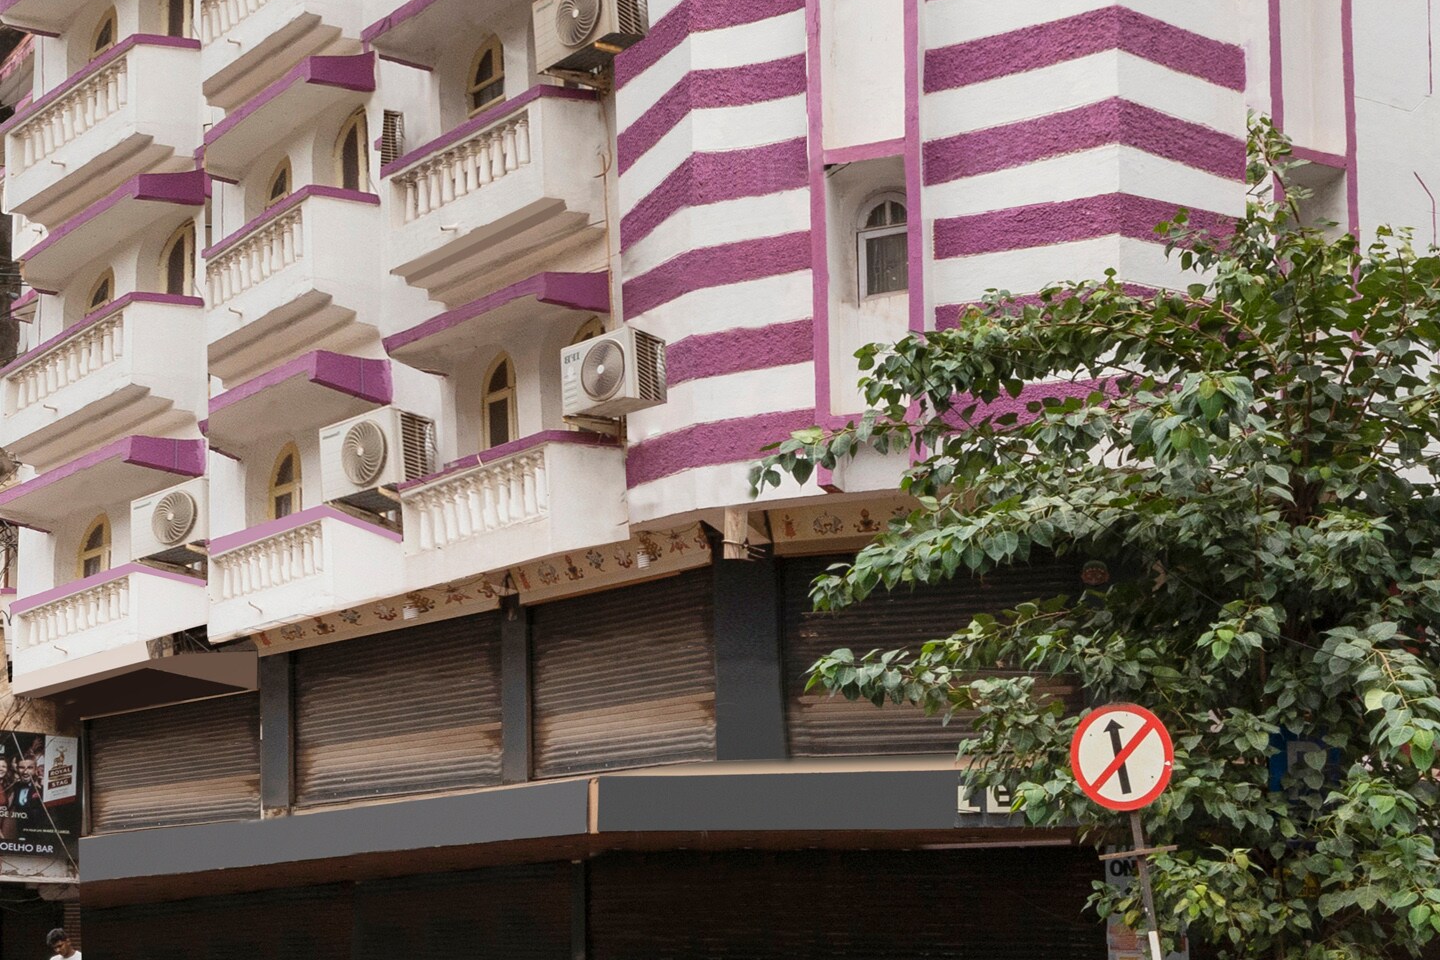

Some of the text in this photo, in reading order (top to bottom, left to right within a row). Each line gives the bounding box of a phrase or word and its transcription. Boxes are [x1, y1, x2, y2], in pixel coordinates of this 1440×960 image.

[50, 767, 71, 776] ROYAL
[0, 842, 54, 853] OELHO BAR
